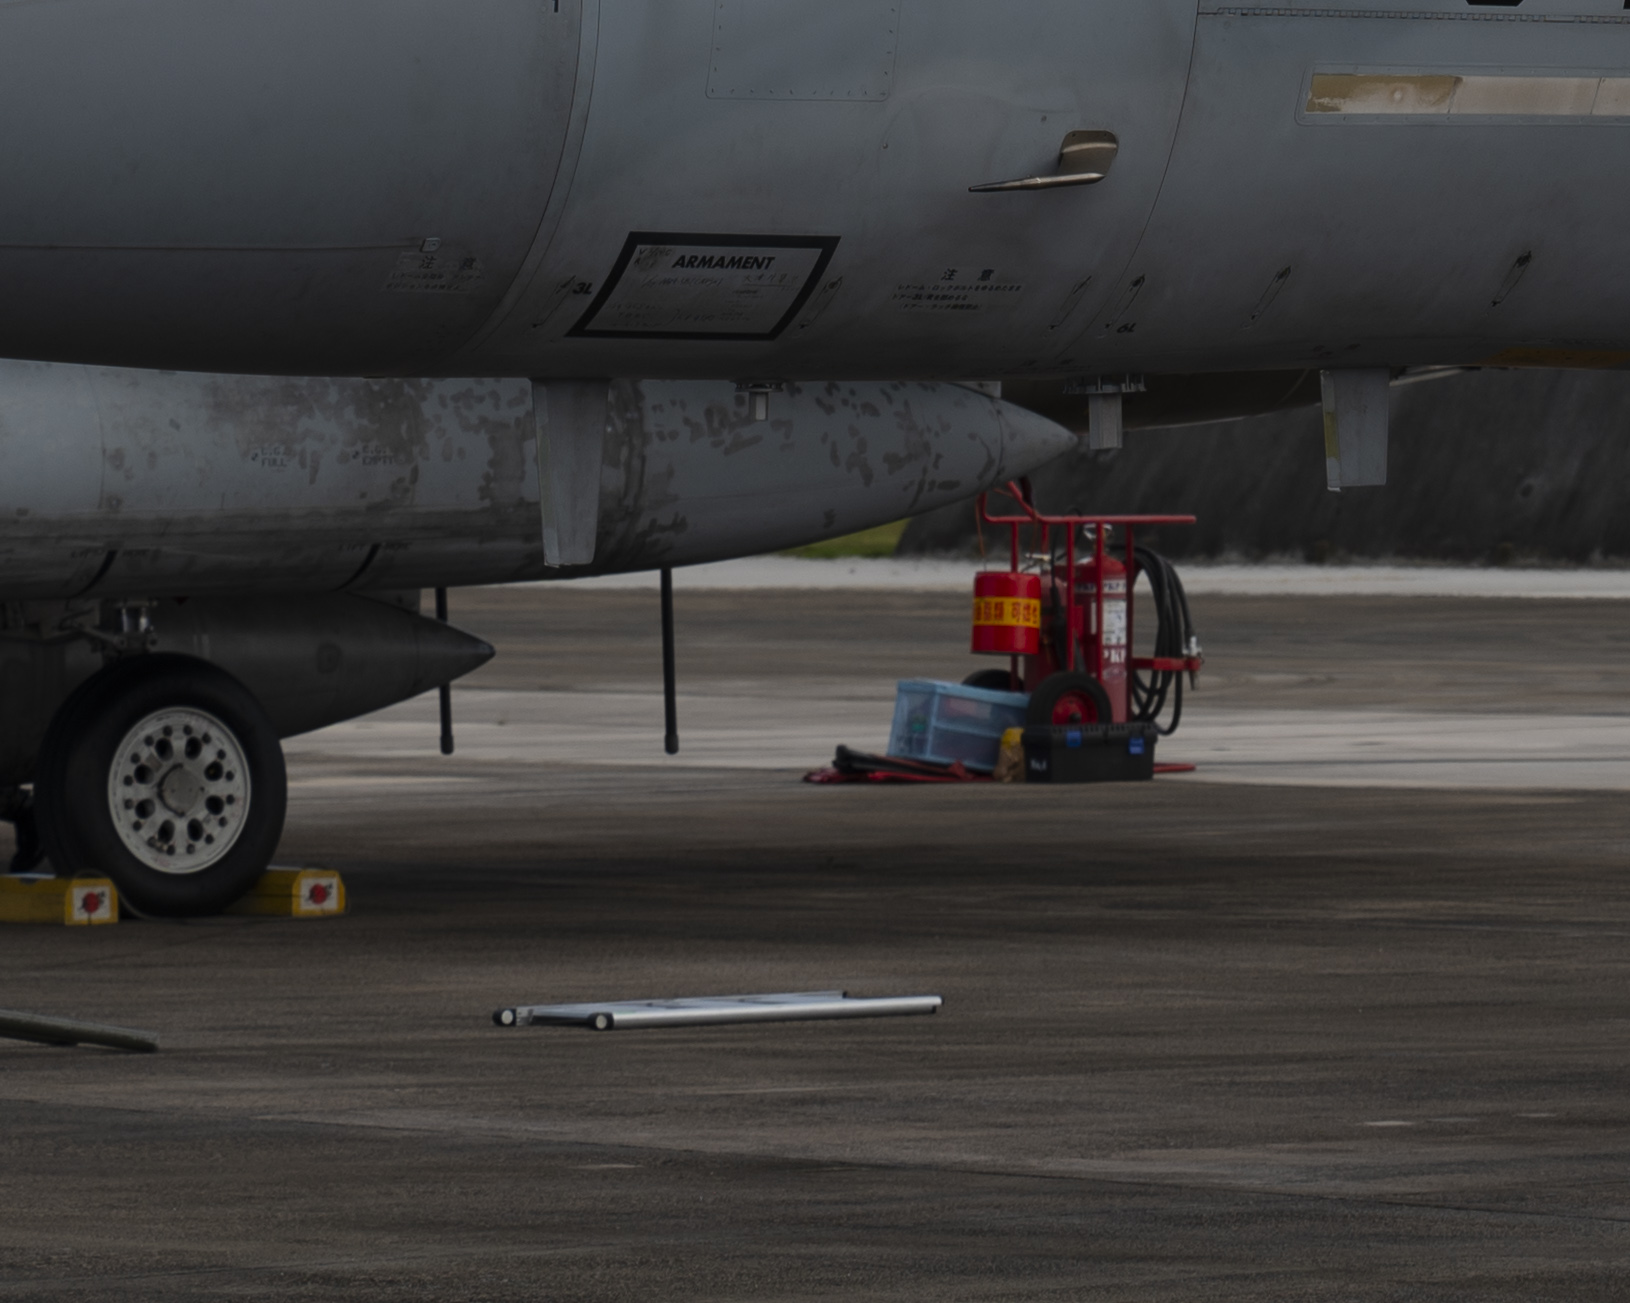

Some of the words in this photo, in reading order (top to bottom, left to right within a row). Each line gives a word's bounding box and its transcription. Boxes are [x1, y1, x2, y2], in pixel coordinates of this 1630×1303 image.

[671, 254, 776, 271] ARMAMENT
[572, 281, 593, 296] 3L
[1116, 322, 1137, 334] 6L
